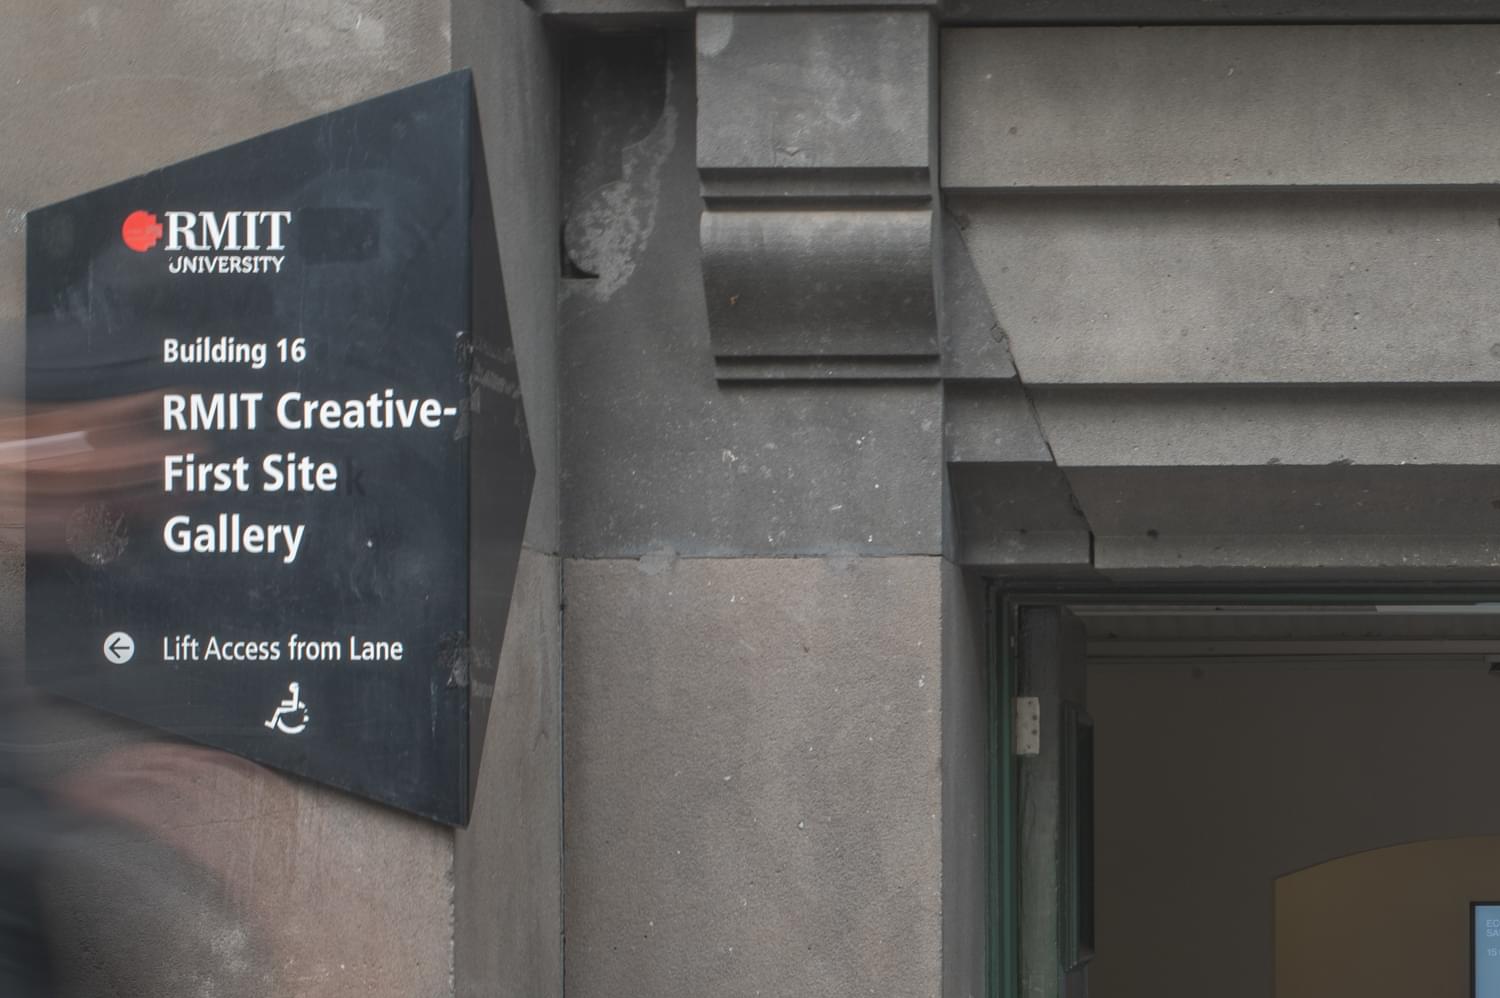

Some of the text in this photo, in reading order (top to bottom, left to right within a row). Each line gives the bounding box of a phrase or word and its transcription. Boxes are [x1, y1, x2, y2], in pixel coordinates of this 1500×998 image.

[164, 211, 292, 251] RMIT
[168, 256, 286, 274] UNIVERSITY
[163, 337, 307, 370] Building 16
[163, 389, 457, 431] RMIT Creative-
[163, 452, 338, 492] First Site
[163, 513, 306, 564] Gallery
[163, 634, 404, 661] Lift Access from Lane
